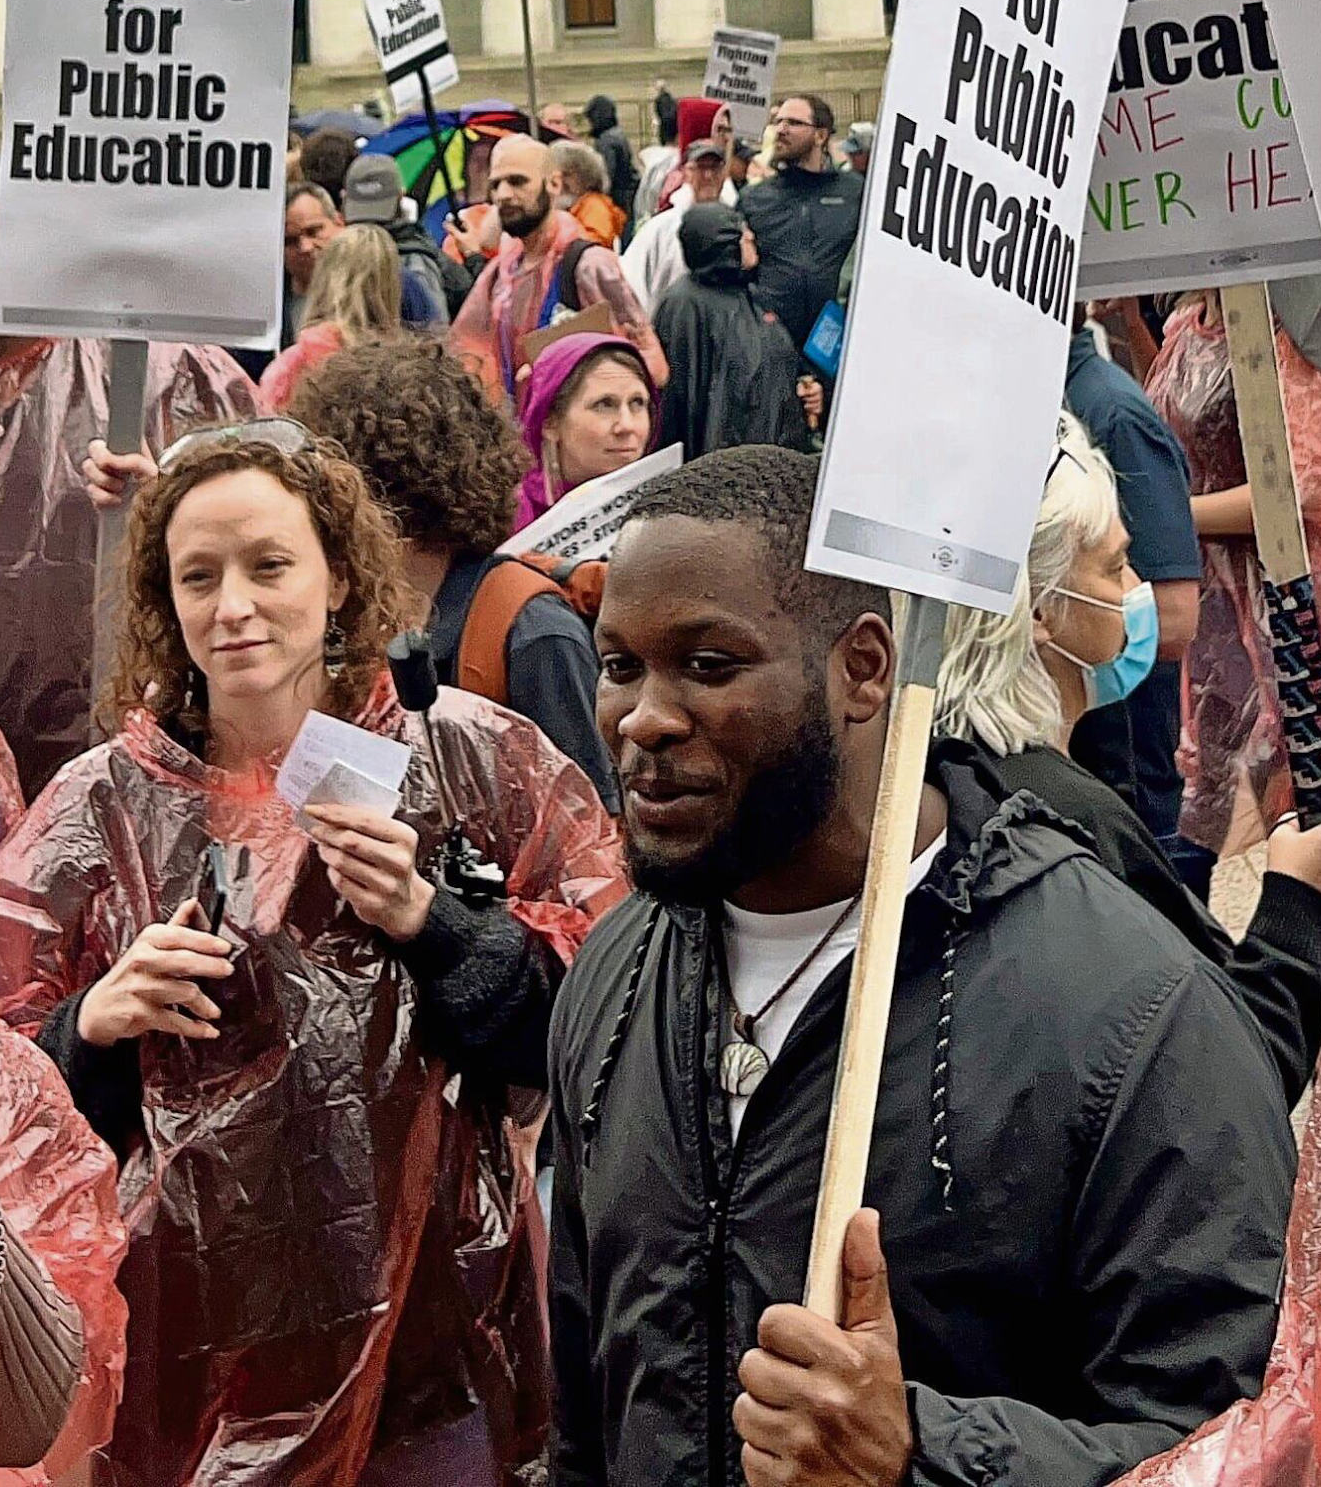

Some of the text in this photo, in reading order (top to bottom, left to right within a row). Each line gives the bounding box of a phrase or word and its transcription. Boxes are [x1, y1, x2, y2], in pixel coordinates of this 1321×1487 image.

[59, 59, 227, 122] Public
[944, 6, 1075, 189] Public
[10, 122, 273, 190] Education
[881, 113, 1076, 326] Education
